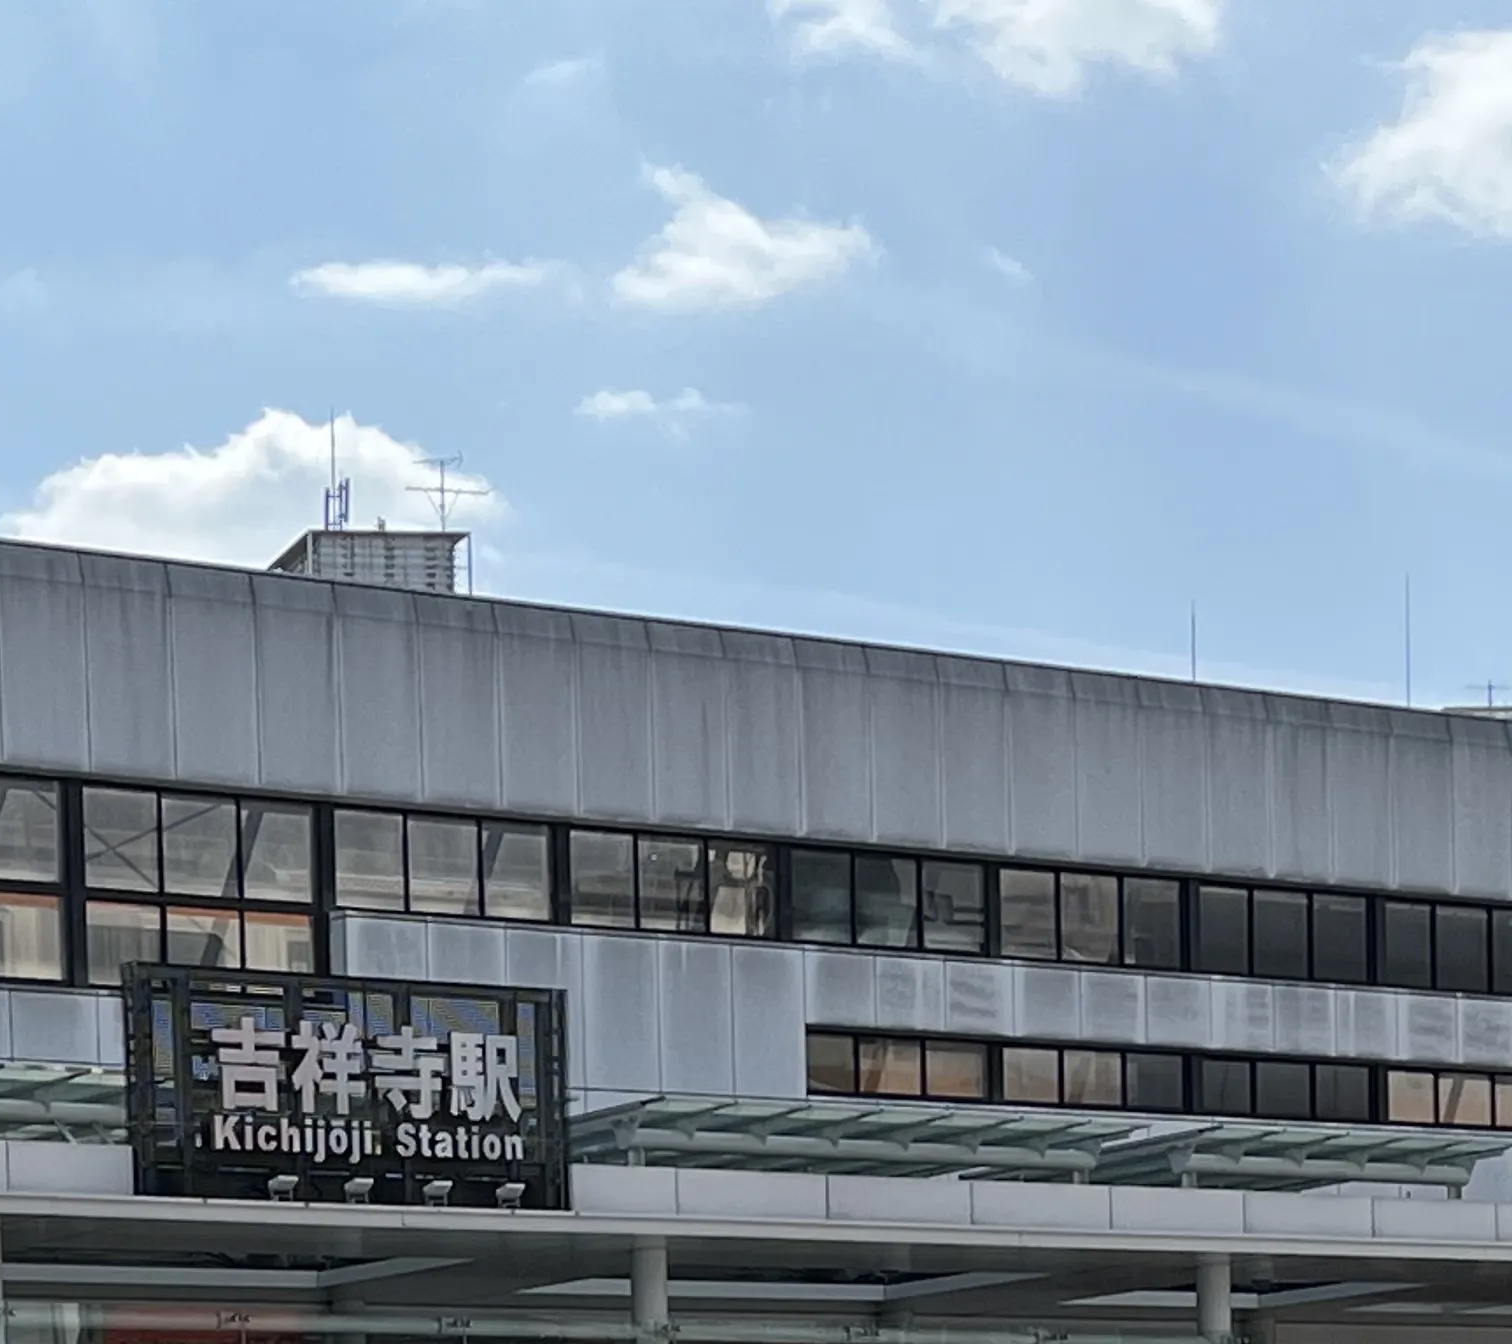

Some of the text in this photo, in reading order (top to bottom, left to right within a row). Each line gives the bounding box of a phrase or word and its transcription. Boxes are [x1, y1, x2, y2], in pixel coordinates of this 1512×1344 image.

[210, 1016, 522, 1124] 吉祥寺駅
[396, 1122, 525, 1161] Station
